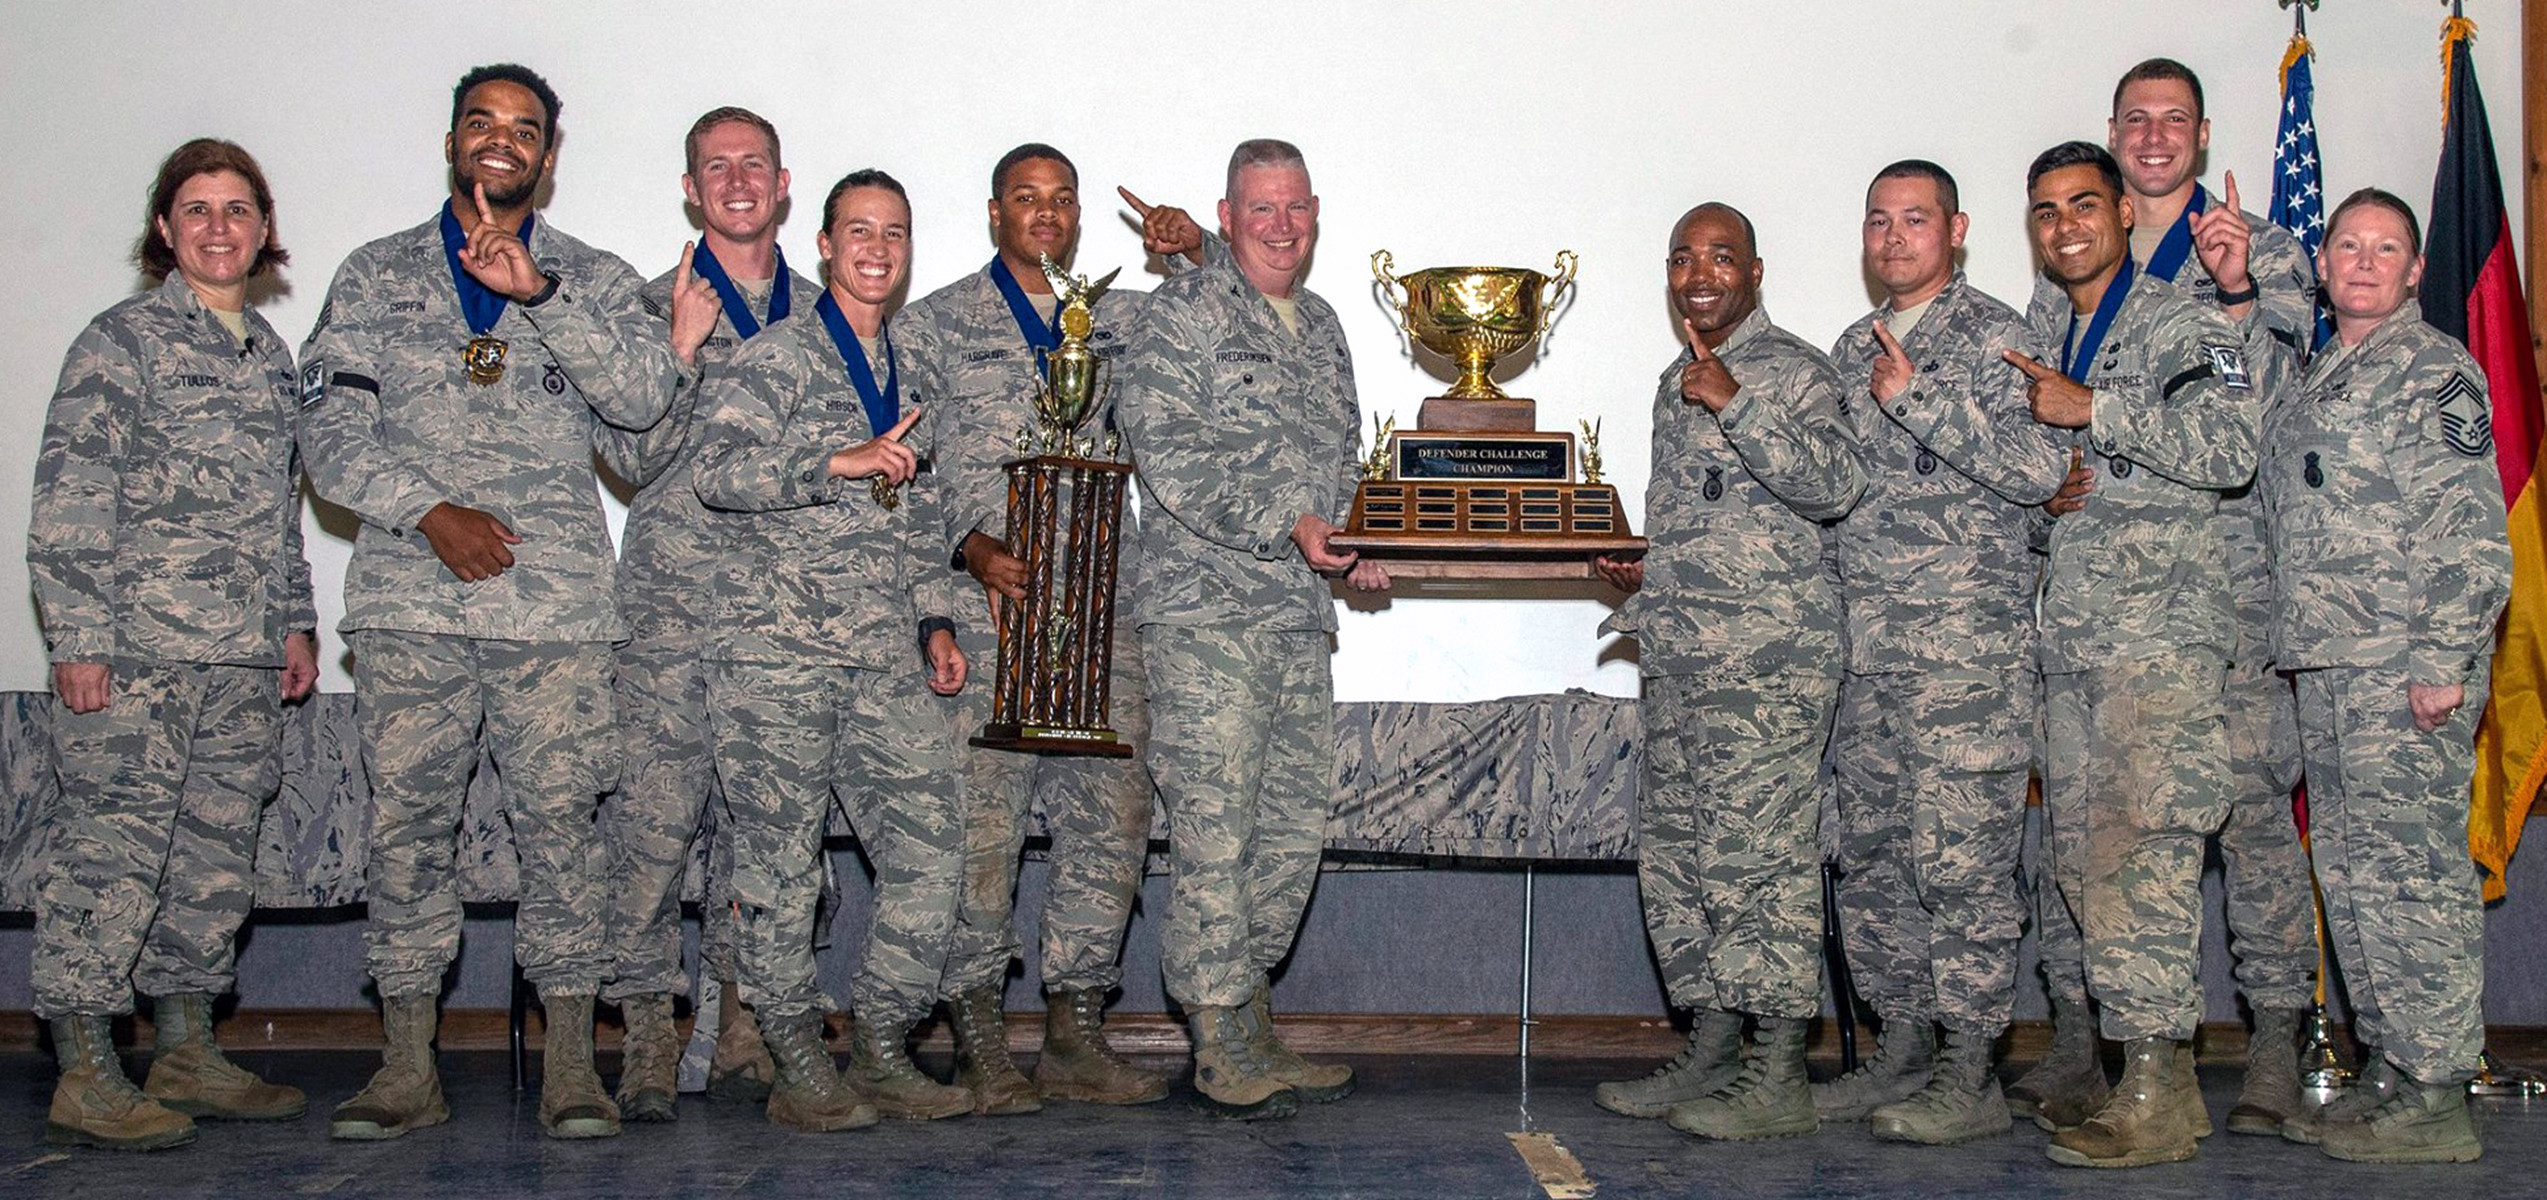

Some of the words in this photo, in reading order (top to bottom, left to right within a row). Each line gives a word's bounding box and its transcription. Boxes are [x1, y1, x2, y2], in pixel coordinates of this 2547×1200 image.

[390, 301, 425, 314] GRIFFIN
[180, 375, 220, 387] TULLOS
[2112, 375, 2143, 388] FORCE
[1418, 449, 1478, 459] DEFENDER
[1479, 450, 1549, 459] CHALLENGE
[1452, 463, 1514, 474] CHAMPION
